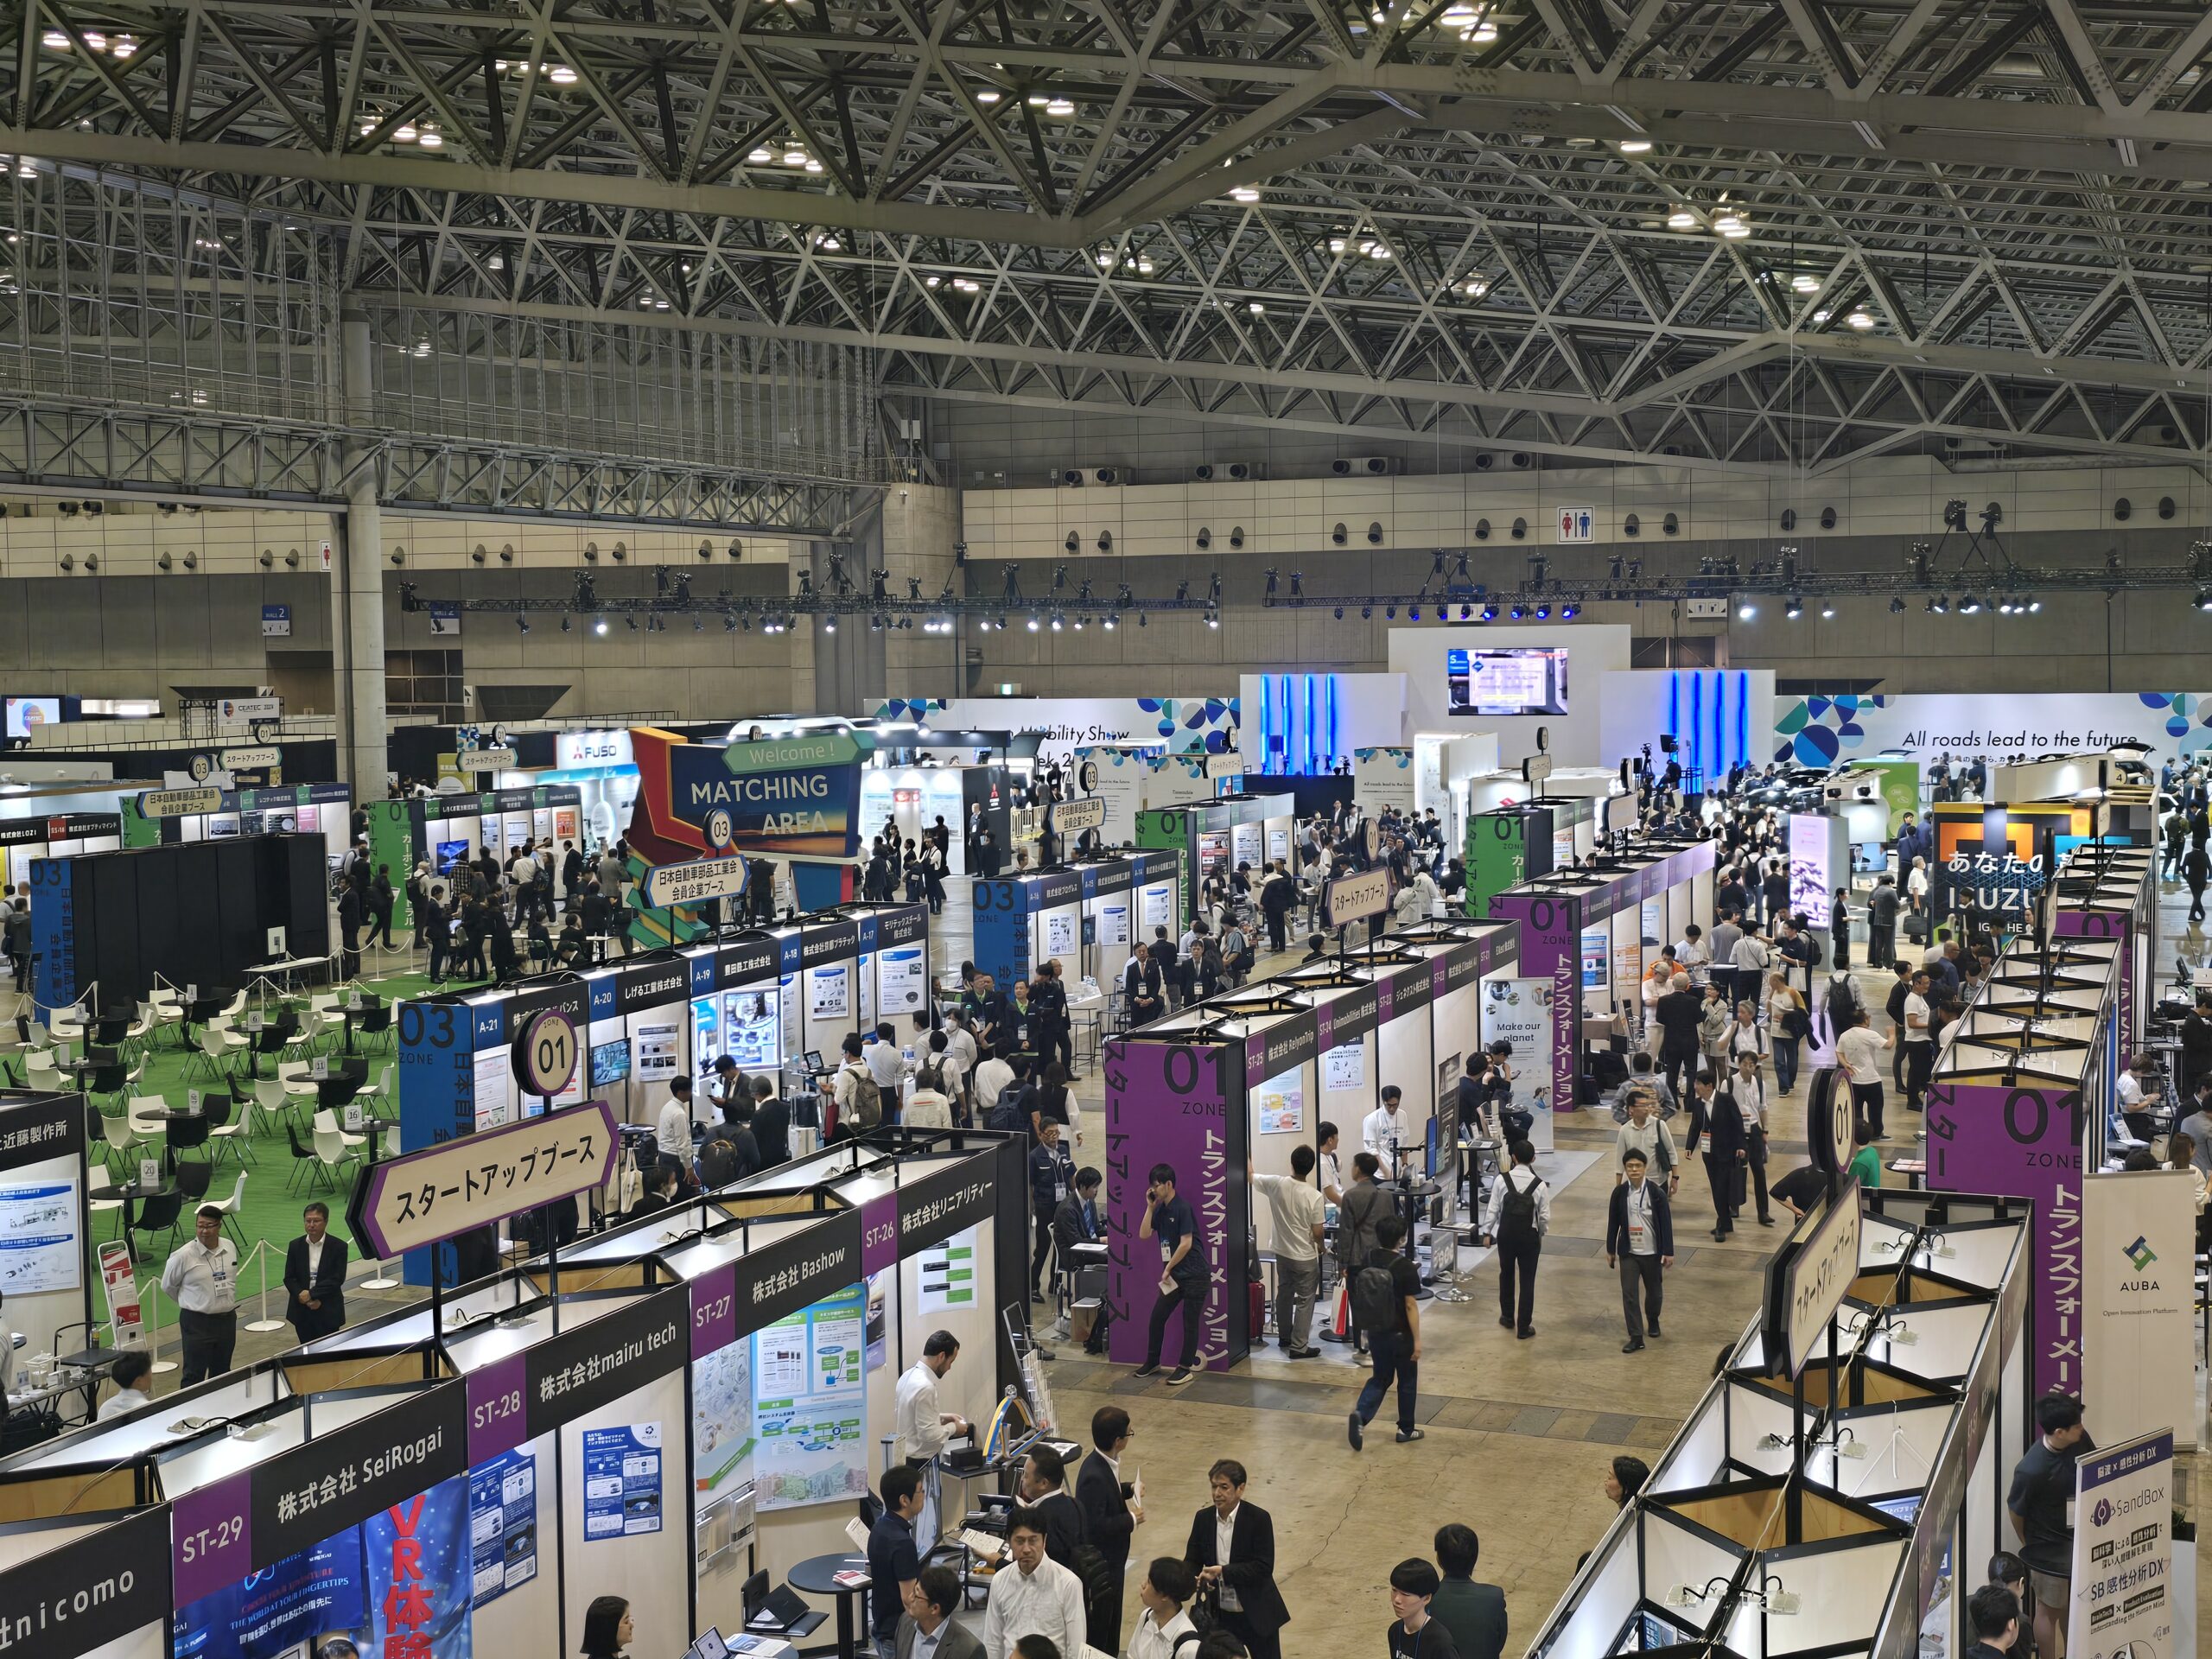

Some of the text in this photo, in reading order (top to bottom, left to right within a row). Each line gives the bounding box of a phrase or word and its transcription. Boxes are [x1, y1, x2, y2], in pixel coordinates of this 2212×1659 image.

[278, 607, 285, 618] 2
[260, 729, 269, 739] 01
[1903, 729, 2138, 748] All roads lead to the future
[226, 751, 276, 764] スタートアップブース
[465, 753, 512, 766] スタートアップブース
[585, 745, 617, 760] FUSO
[749, 743, 826, 765] Welcome
[195, 762, 207, 774] 03
[1087, 772, 1096, 784] 03
[149, 790, 216, 805] 日本自動車部品工業会
[690, 774, 829, 805] MATCHING
[161, 802, 206, 815] 会員企業ブース
[1056, 798, 1101, 818] 日本自動車部品工業会
[713, 820, 728, 836] 03
[761, 810, 830, 836] AREA
[1064, 812, 1095, 829] 会員企業ブース
[1160, 812, 1189, 835] 01
[1494, 817, 1524, 841] 01
[1369, 830, 1378, 848] 01
[30, 861, 62, 886] 03
[658, 861, 738, 887] 日本自動車部品工業会
[671, 880, 725, 901] 会員企業ブース
[973, 882, 1015, 912] 03
[1333, 882, 1388, 913] スタートアップブース
[883, 912, 922, 931] モリテックスチール
[974, 914, 1000, 924] ZONE
[1530, 899, 1573, 931] 01
[862, 930, 874, 941] A-17
[893, 929, 912, 940] 株式会社
[1542, 935, 1573, 944] ZONE
[784, 948, 798, 961] A-18
[804, 935, 855, 957] 株式会社プラテック
[695, 969, 711, 983] A-19
[594, 992, 612, 1006] A-20
[1395, 976, 1431, 1001] ジェネクスト株式会社
[1379, 993, 1393, 1008] ST-23
[399, 1003, 455, 1049] 03
[479, 1018, 499, 1033] A-21
[1318, 1019, 1332, 1038] ST-24
[1497, 1022, 1523, 1032] Make
[1554, 953, 1573, 1107] トランスフォーメーション
[1503, 1033, 1535, 1042] planet
[399, 1052, 435, 1065] ZONE
[538, 1034, 566, 1075] 01
[1248, 1052, 1263, 1071] ST-25
[1267, 1039, 1288, 1063] 株式会社
[1163, 1044, 1226, 1097] 01
[1182, 1101, 1226, 1117] ZONE
[2003, 1088, 2081, 1147] 01
[1836, 1097, 1849, 1146] 01
[2026, 1153, 2082, 1168] ZONE
[396, 1135, 596, 1224] スタートアップブース
[901, 1180, 994, 1236] 株式会社リニアリティー
[866, 1220, 894, 1249] ST-26
[1201, 1128, 1229, 1363] トランスフォーメーション
[751, 1246, 846, 1306] 株式会社 Bashow
[2120, 1281, 2160, 1292] AUBA
[696, 1294, 732, 1328] ST-27
[646, 1323, 677, 1353] tech
[474, 1389, 521, 1428] ST-28
[2119, 1450, 2145, 1471] 感性分析
[2146, 1446, 2157, 1459] DX
[276, 1426, 443, 1524] 株式会社 SeiRogai
[181, 1515, 244, 1563] ST-29
[2091, 1557, 2164, 1601] SB 感性分析 DX
[231, 1619, 246, 1630] THE
[247, 1606, 270, 1625] WORLD
[2091, 1614, 2127, 1635] Understanding
[2127, 1611, 2136, 1620] the
[2135, 1605, 2152, 1617] Human
